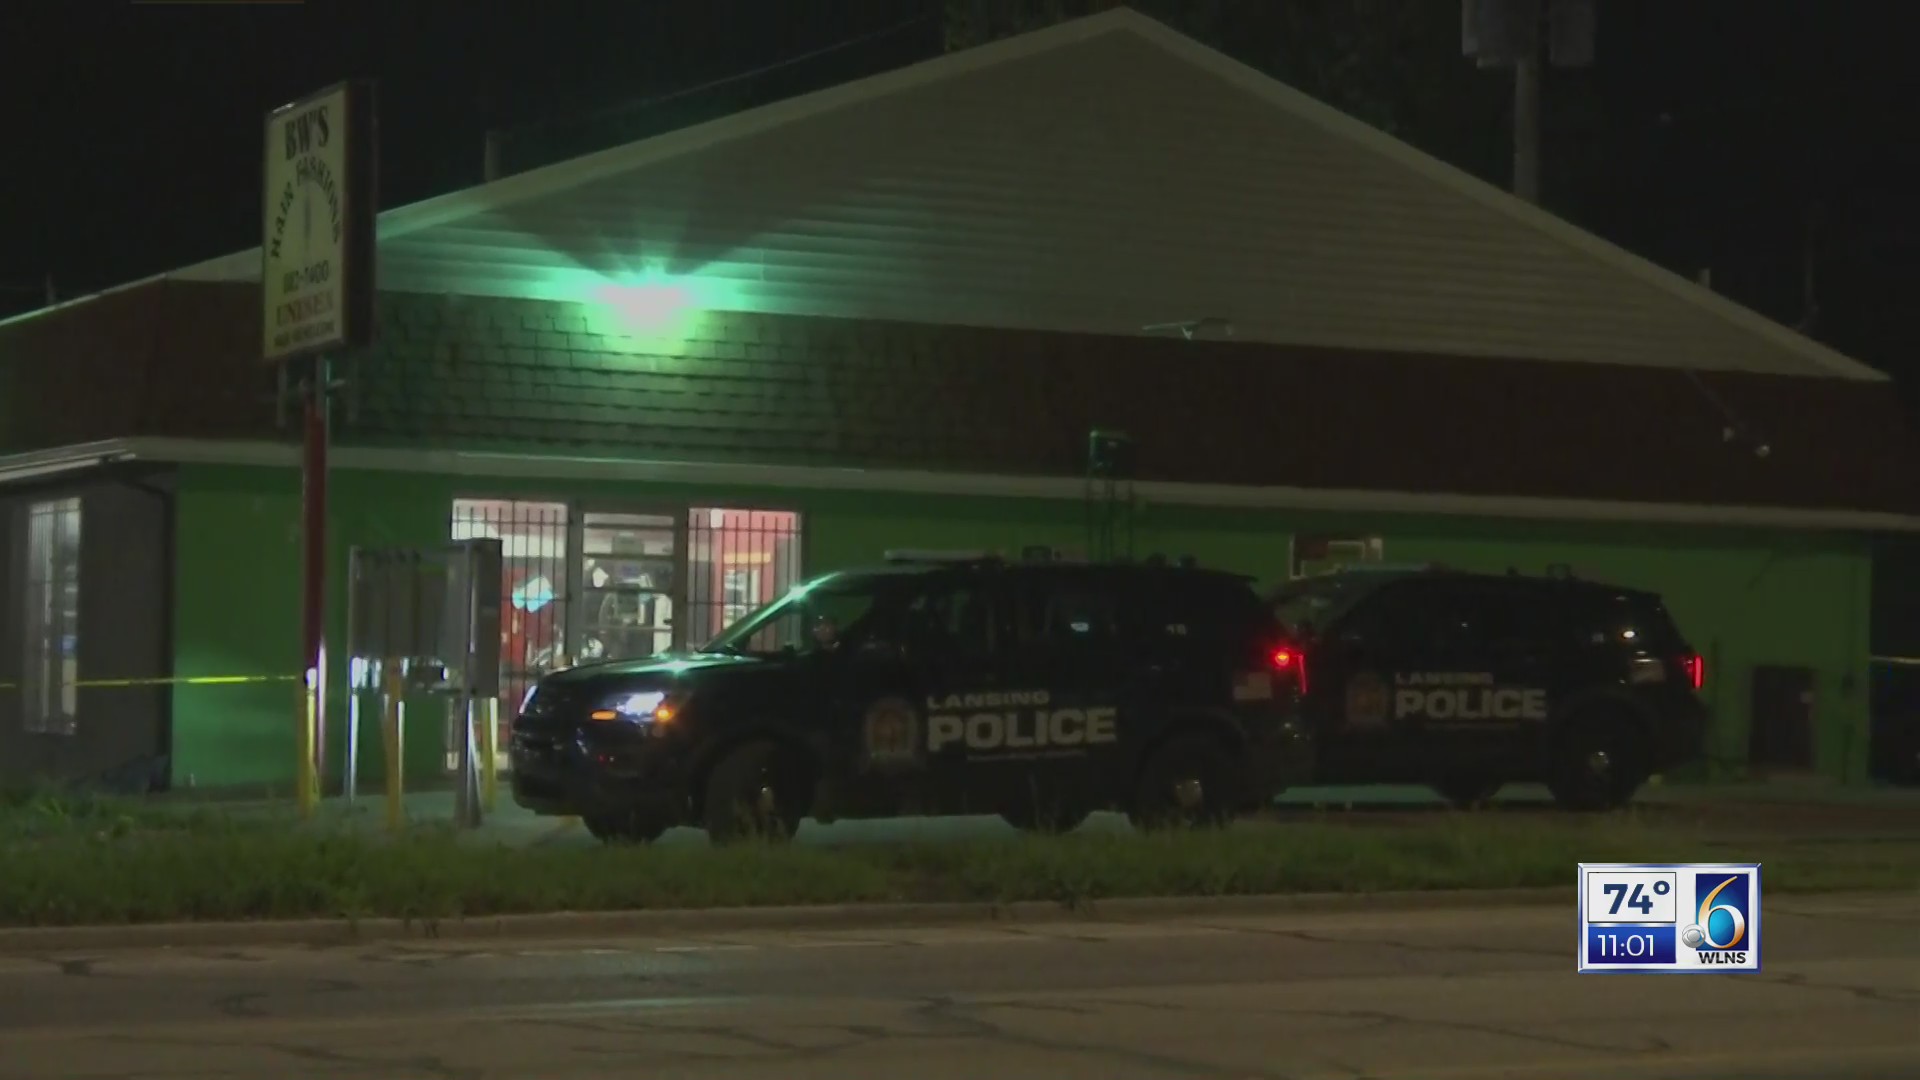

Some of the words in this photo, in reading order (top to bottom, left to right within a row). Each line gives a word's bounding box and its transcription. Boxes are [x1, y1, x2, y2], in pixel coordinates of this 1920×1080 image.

[270, 181, 294, 258] HAIR
[295, 157, 340, 243] FASHIONS
[276, 289, 334, 326] UNISEX
[1395, 671, 1494, 685] LANSING
[926, 690, 1051, 710] LANSING
[1395, 688, 1547, 720] POLICE
[926, 706, 1118, 753] POLICE
